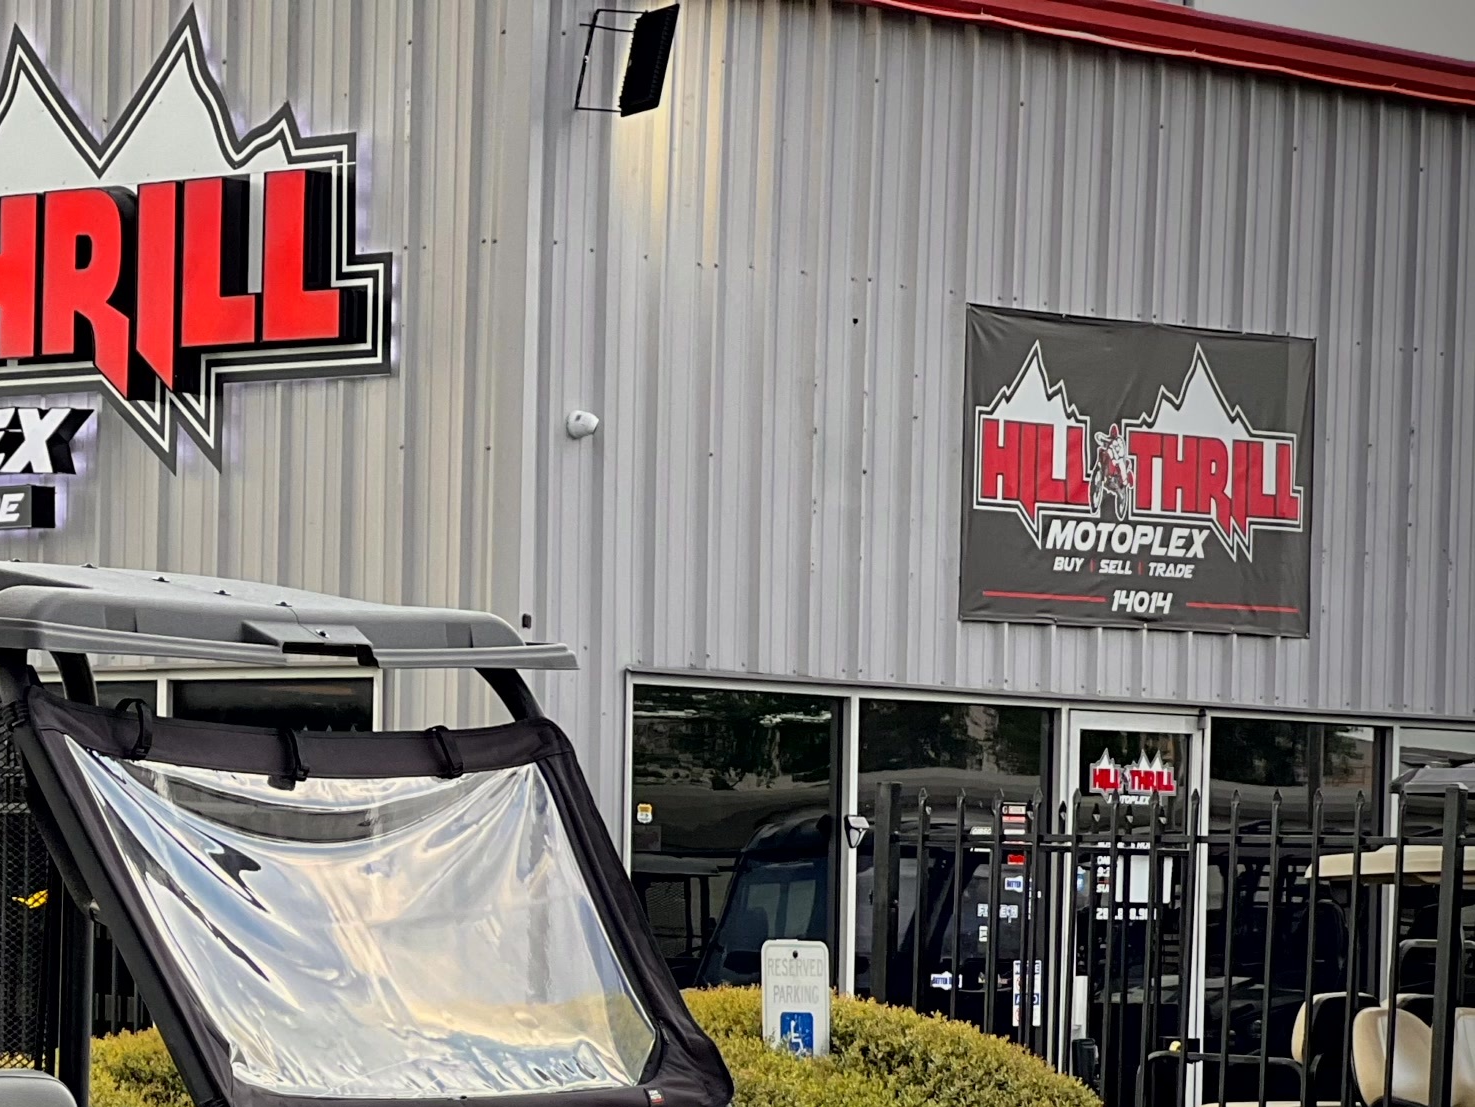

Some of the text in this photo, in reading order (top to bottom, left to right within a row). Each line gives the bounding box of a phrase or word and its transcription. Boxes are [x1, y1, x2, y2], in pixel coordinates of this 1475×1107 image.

[980, 418, 1300, 536] HILL THRILL
[1045, 519, 1210, 559] MOTOPLEX
[1053, 556, 1195, 579] BUY SELL TRADE
[1111, 590, 1173, 614] 14014
[1093, 768, 1175, 792] HILL THRILL
[767, 958, 824, 977] RESERVED
[773, 985, 820, 1004] PARKING
